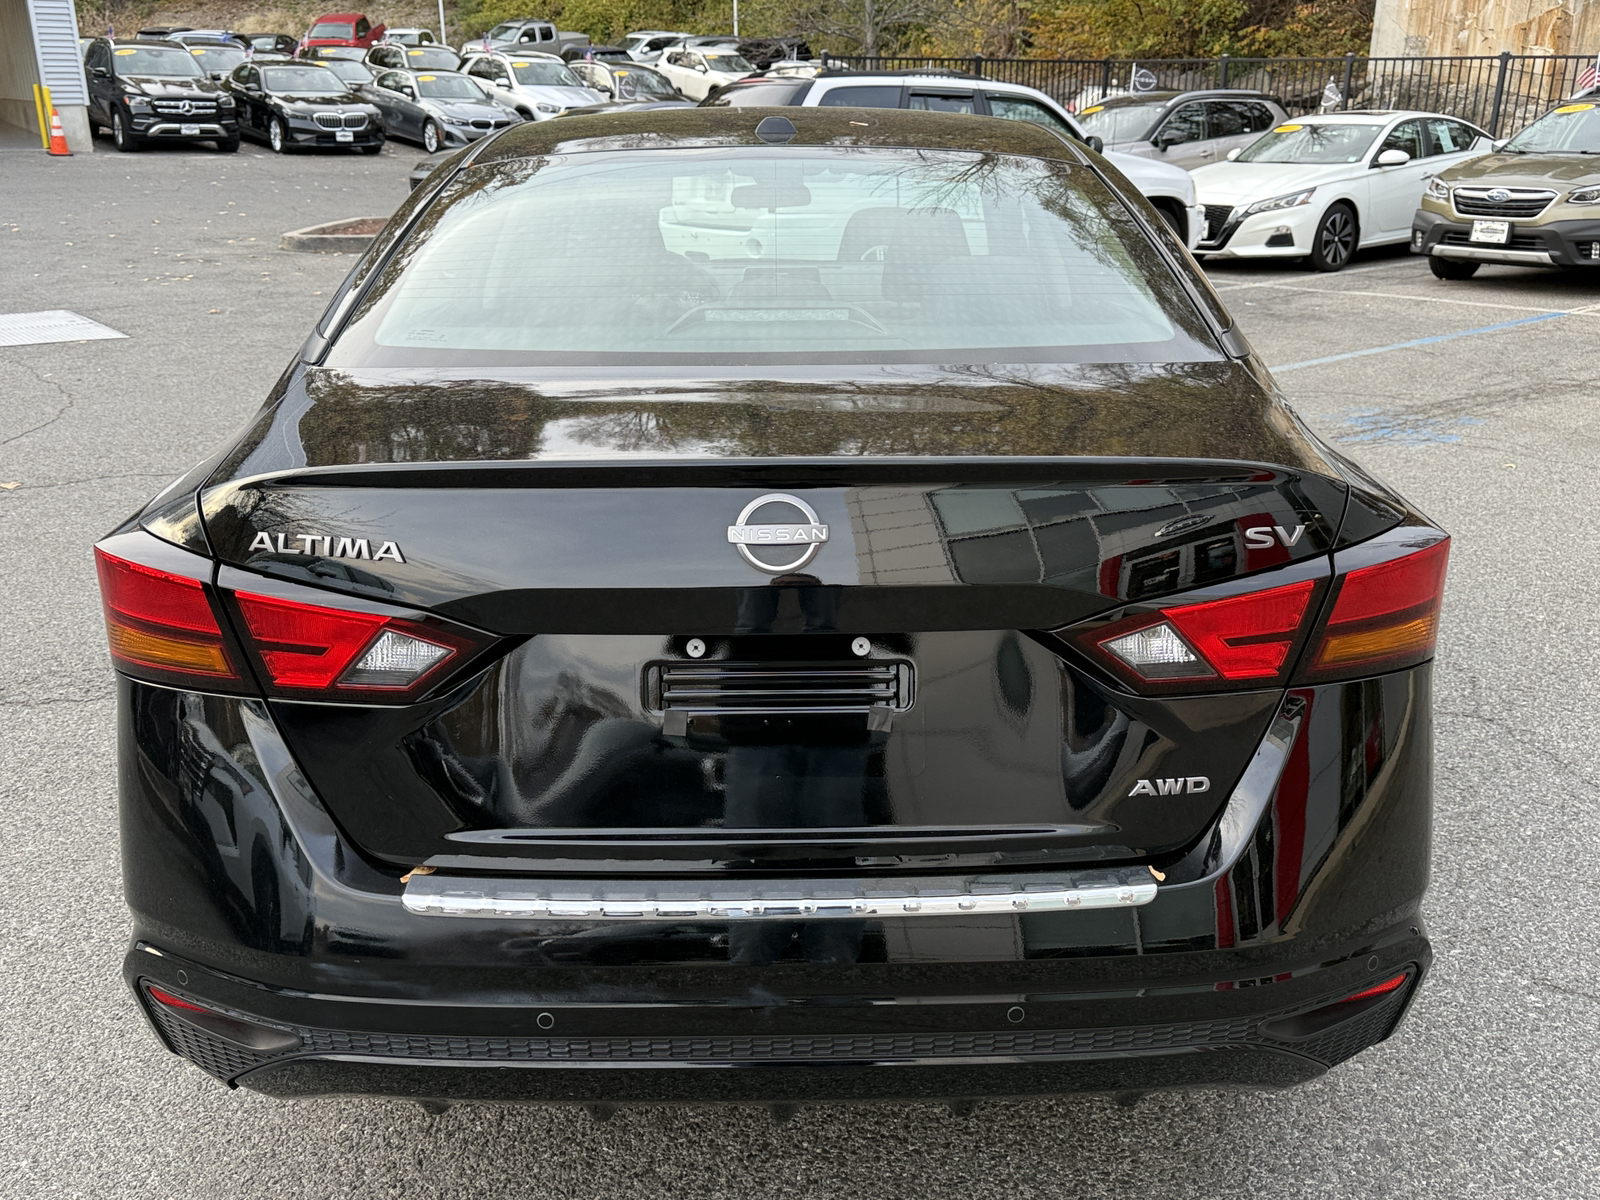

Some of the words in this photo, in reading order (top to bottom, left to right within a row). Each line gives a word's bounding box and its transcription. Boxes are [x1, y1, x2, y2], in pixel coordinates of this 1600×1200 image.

[730, 528, 826, 541] NISSAN
[1245, 525, 1306, 549] SV
[248, 531, 406, 563] ALTIMA
[1128, 776, 1211, 797] AWD
